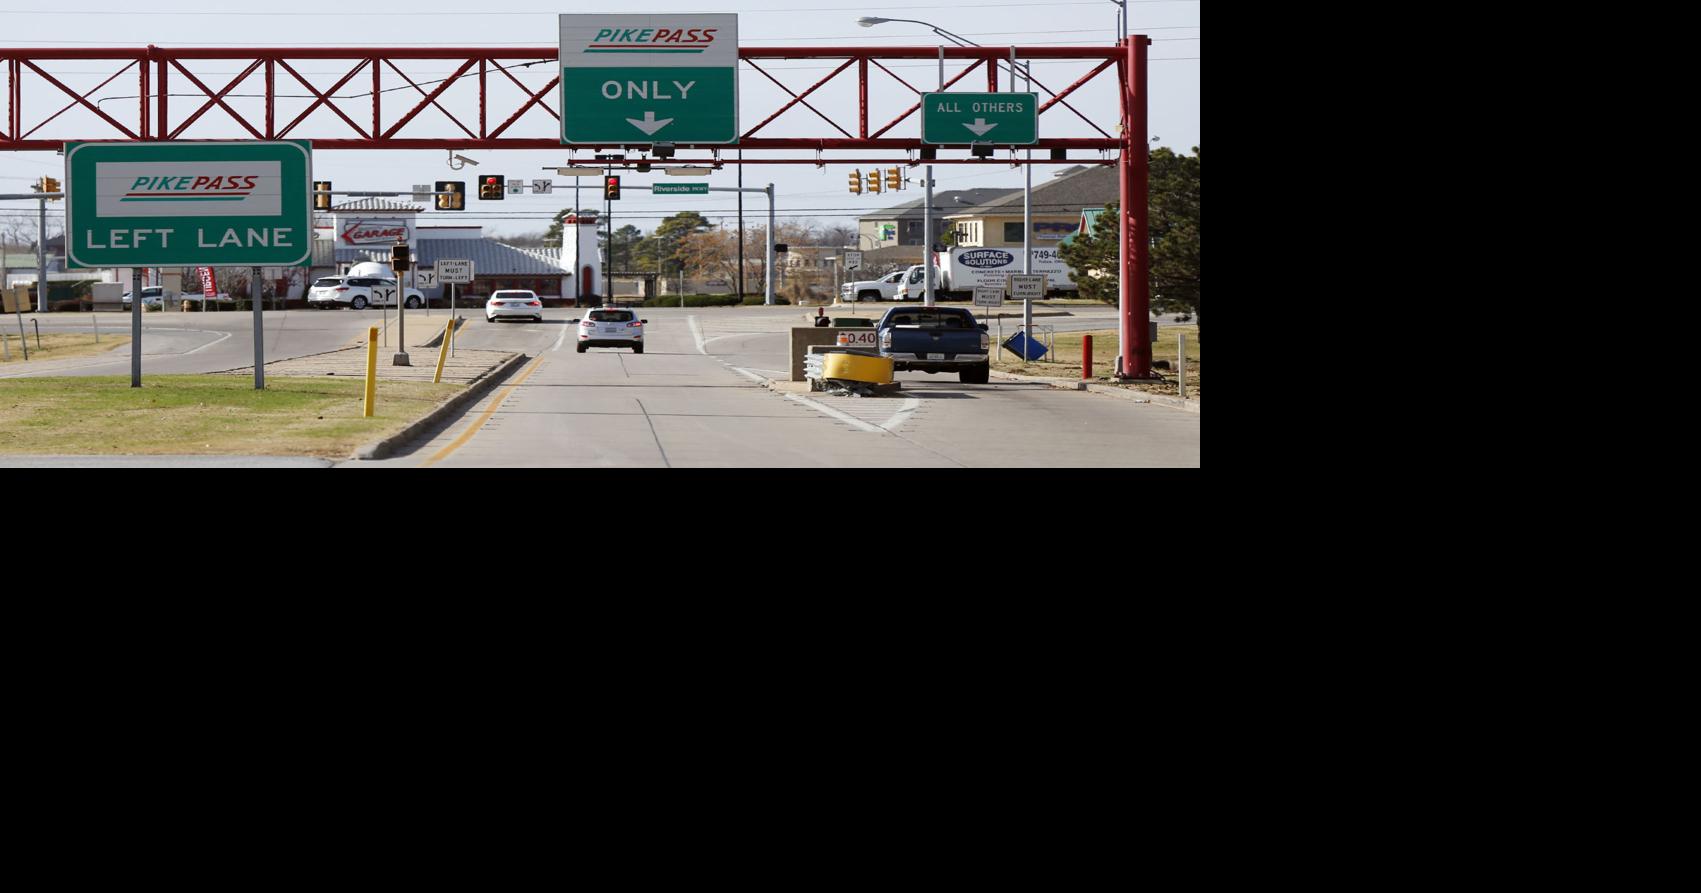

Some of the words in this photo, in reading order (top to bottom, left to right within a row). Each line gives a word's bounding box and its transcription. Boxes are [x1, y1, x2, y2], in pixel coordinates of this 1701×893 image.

[594, 29, 718, 43] PIKEPASS
[601, 80, 696, 100] ONLY
[937, 102, 962, 113] ALL
[972, 102, 1024, 113] OTHERS
[131, 175, 259, 191] PIKEPASS
[655, 185, 690, 193] Riverside
[86, 229, 175, 249] LEFT
[198, 227, 293, 248] LANE
[353, 227, 405, 240] GARAGE
[963, 251, 1009, 260] SURFACE
[964, 258, 1008, 266] SOLUTIONS
